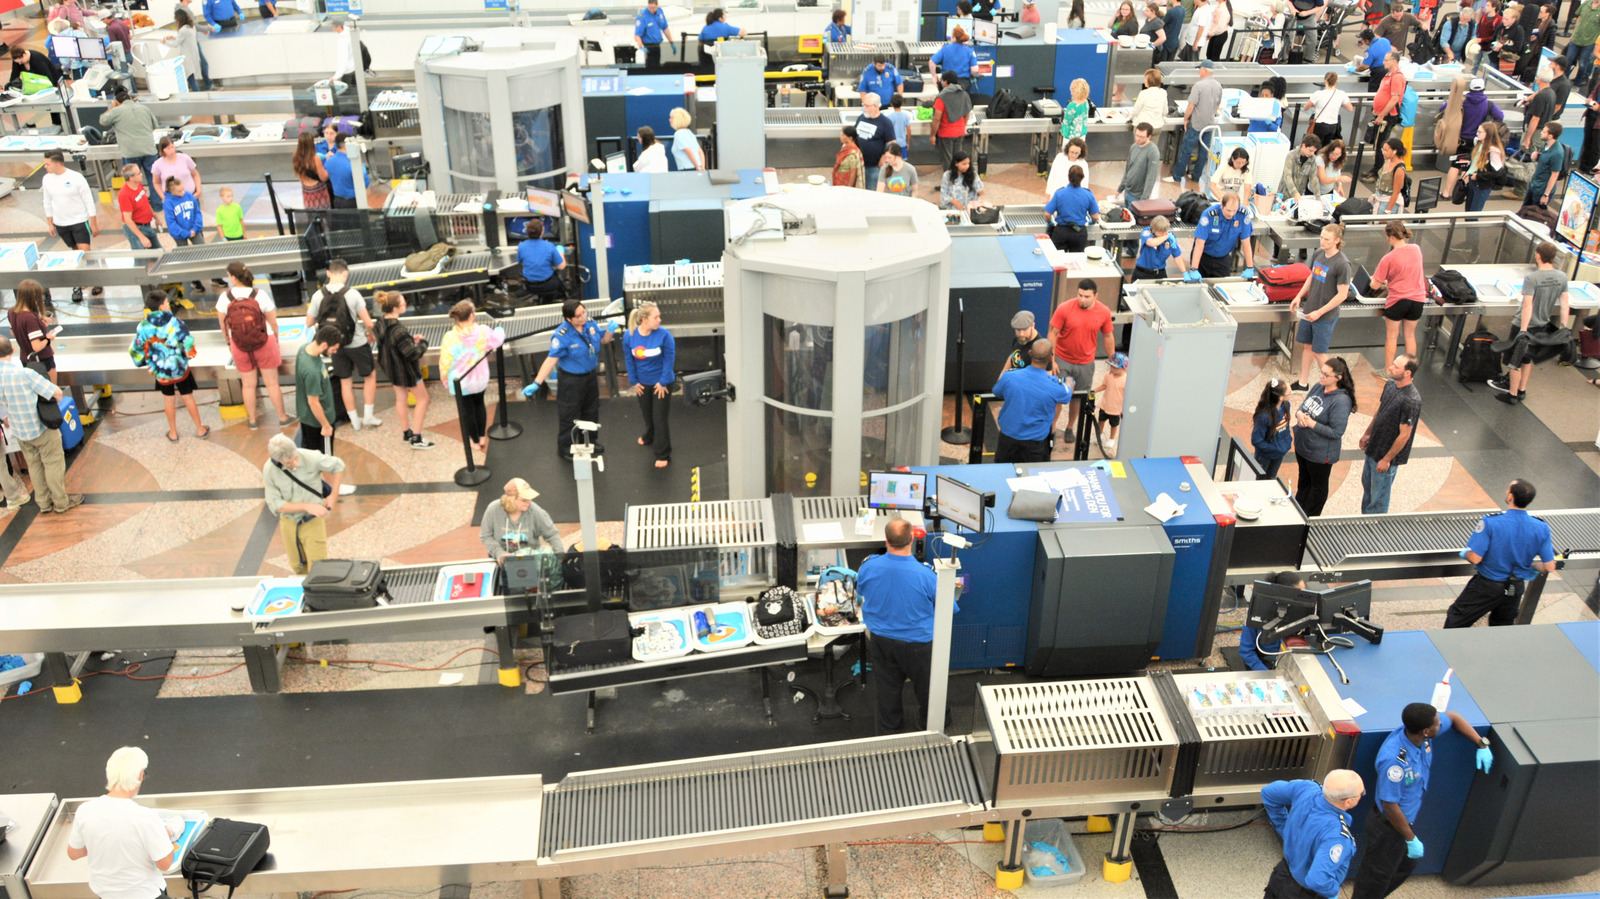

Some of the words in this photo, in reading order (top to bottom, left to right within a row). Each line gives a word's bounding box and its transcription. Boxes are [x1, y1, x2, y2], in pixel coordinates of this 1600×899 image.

[1086, 469, 1102, 491] THANK
[1094, 491, 1107, 504] YOU
[1086, 500, 1099, 513] DEN
[1099, 505, 1112, 518] FOR
